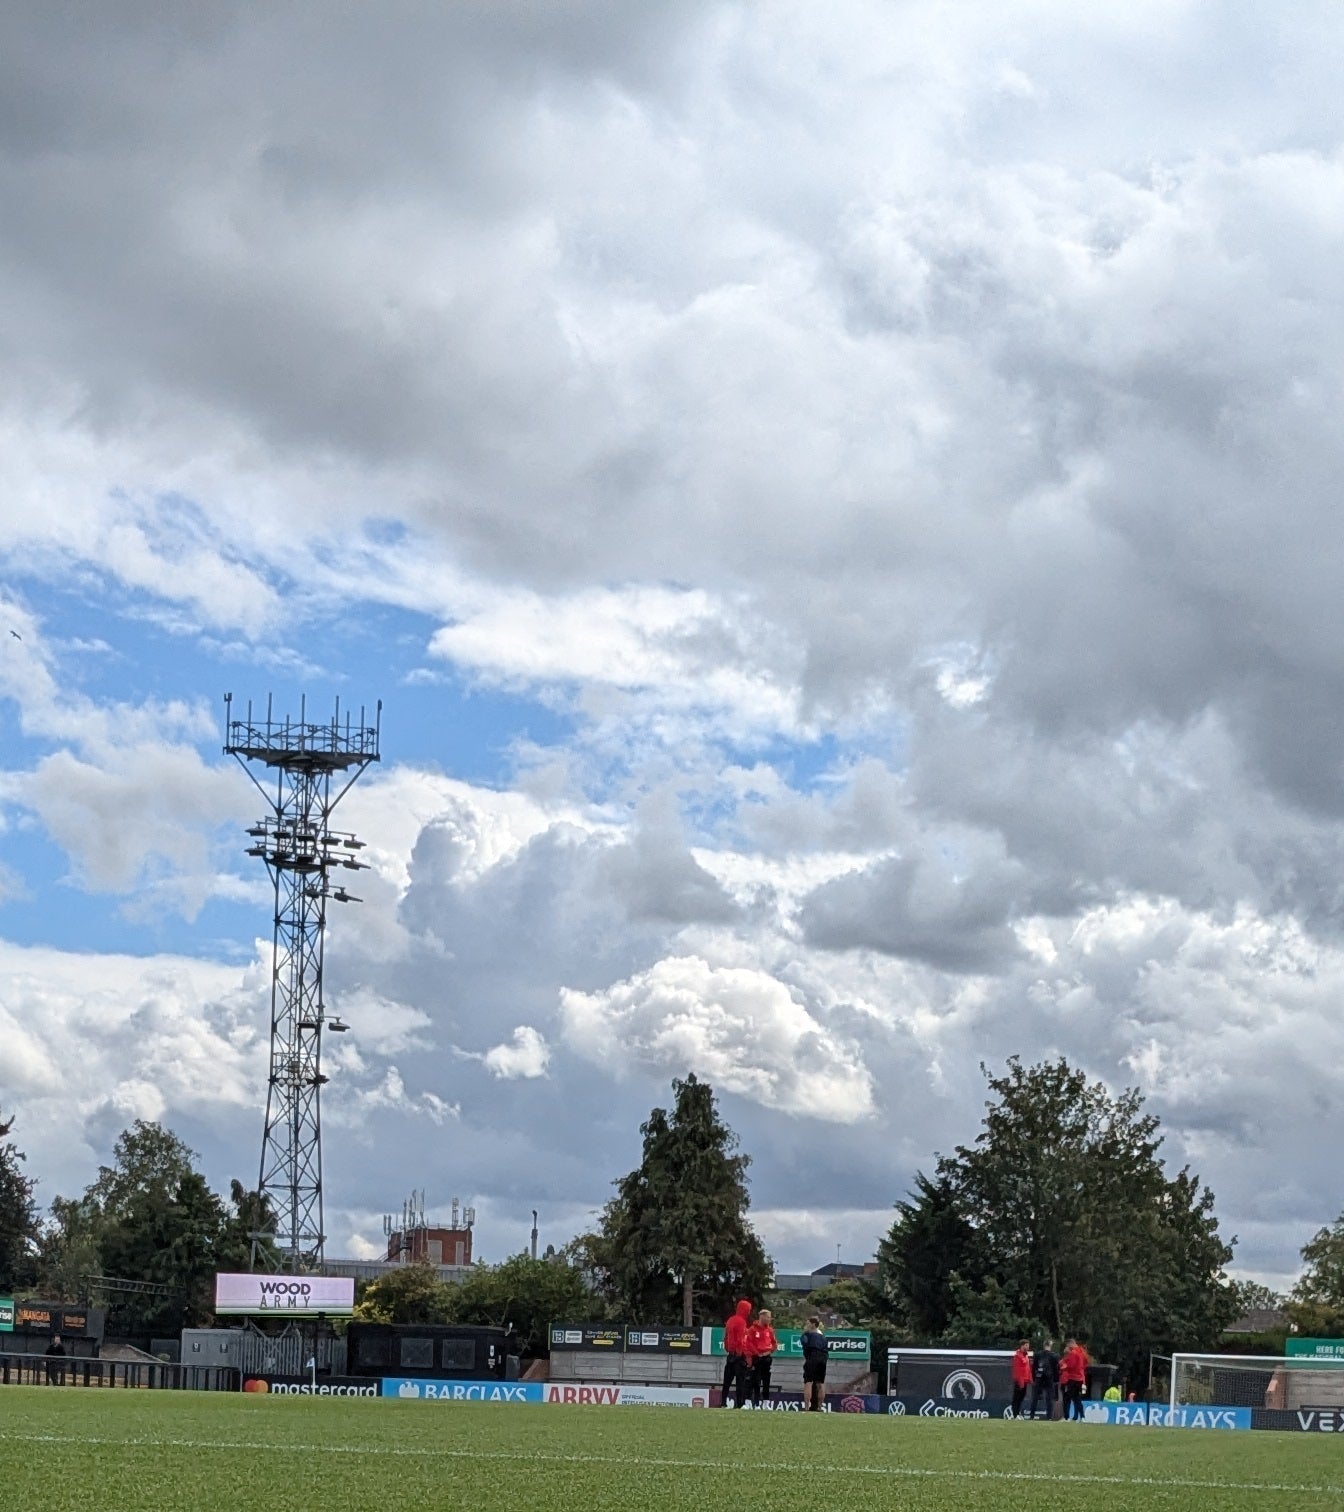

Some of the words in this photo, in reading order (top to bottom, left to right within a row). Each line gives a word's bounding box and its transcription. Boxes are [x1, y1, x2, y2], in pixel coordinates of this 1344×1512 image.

[260, 1282, 311, 1295] WOOD
[259, 1295, 311, 1309] ARMY
[827, 1338, 866, 1350] rprise
[272, 1383, 377, 1397] mastercard
[425, 1384, 527, 1402] BARCLAYS
[1115, 1406, 1237, 1430] BARCLAYS
